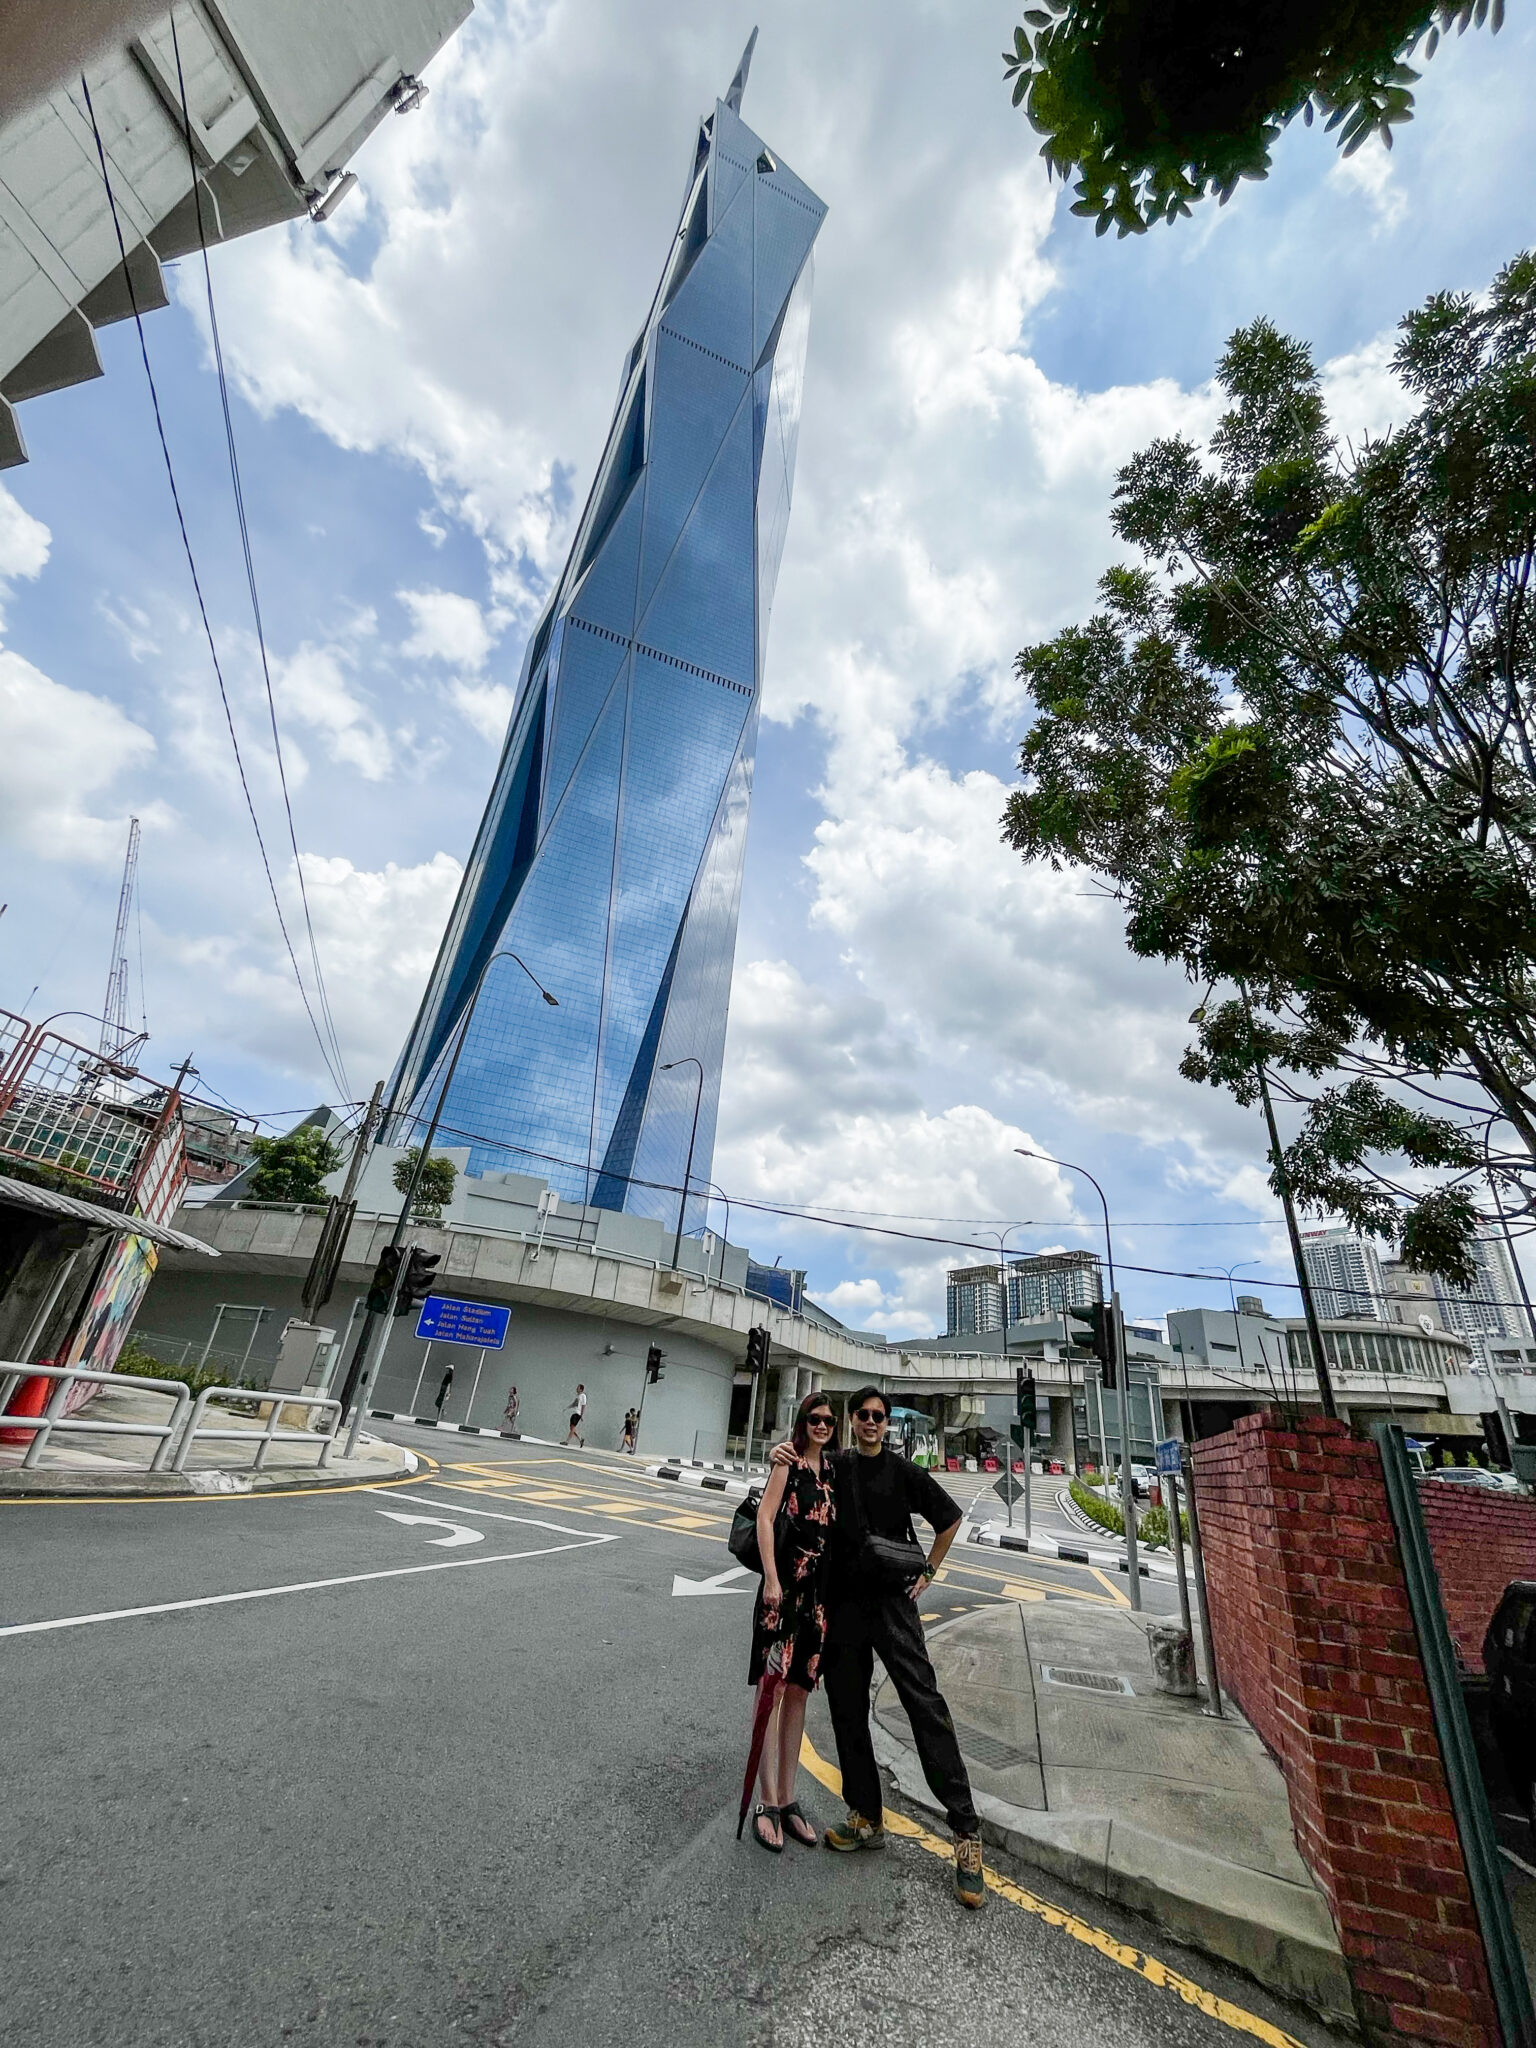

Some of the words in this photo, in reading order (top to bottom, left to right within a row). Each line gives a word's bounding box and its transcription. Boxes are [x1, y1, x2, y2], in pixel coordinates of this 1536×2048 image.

[441, 1303, 460, 1312] Jalan
[440, 1312, 458, 1321] Jalan
[461, 1315, 484, 1324] Sultan
[437, 1321, 456, 1330] Jalan
[458, 1324, 476, 1334] Hang
[480, 1327, 496, 1335] Tuah
[435, 1330, 453, 1338] Jalan
